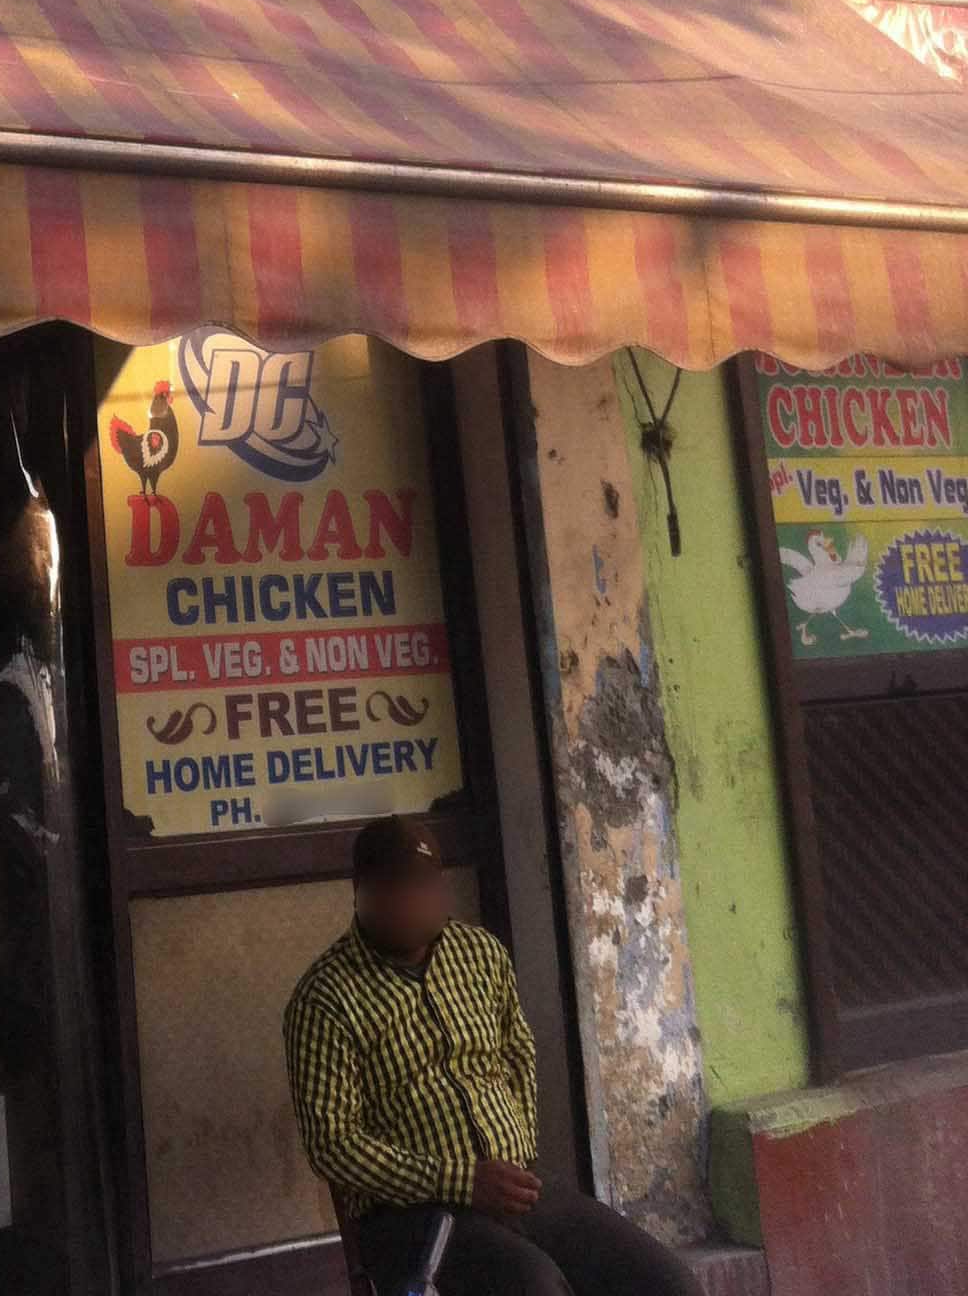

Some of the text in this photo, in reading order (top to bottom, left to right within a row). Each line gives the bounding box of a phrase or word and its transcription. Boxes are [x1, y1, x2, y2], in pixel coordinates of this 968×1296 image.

[198, 349, 313, 447] DC
[768, 385, 951, 448] CHICKEN
[854, 469, 876, 505] &
[878, 468, 925, 505] Non
[125, 487, 419, 568] DAMAN
[900, 543, 964, 583] FREE
[166, 570, 396, 625] CHICKEN
[129, 629, 440, 685] SPL. VEG. & NON VEG.
[224, 686, 361, 741] FREE
[145, 737, 440, 795] HOME DELIVERY
[209, 796, 263, 827] PH.
